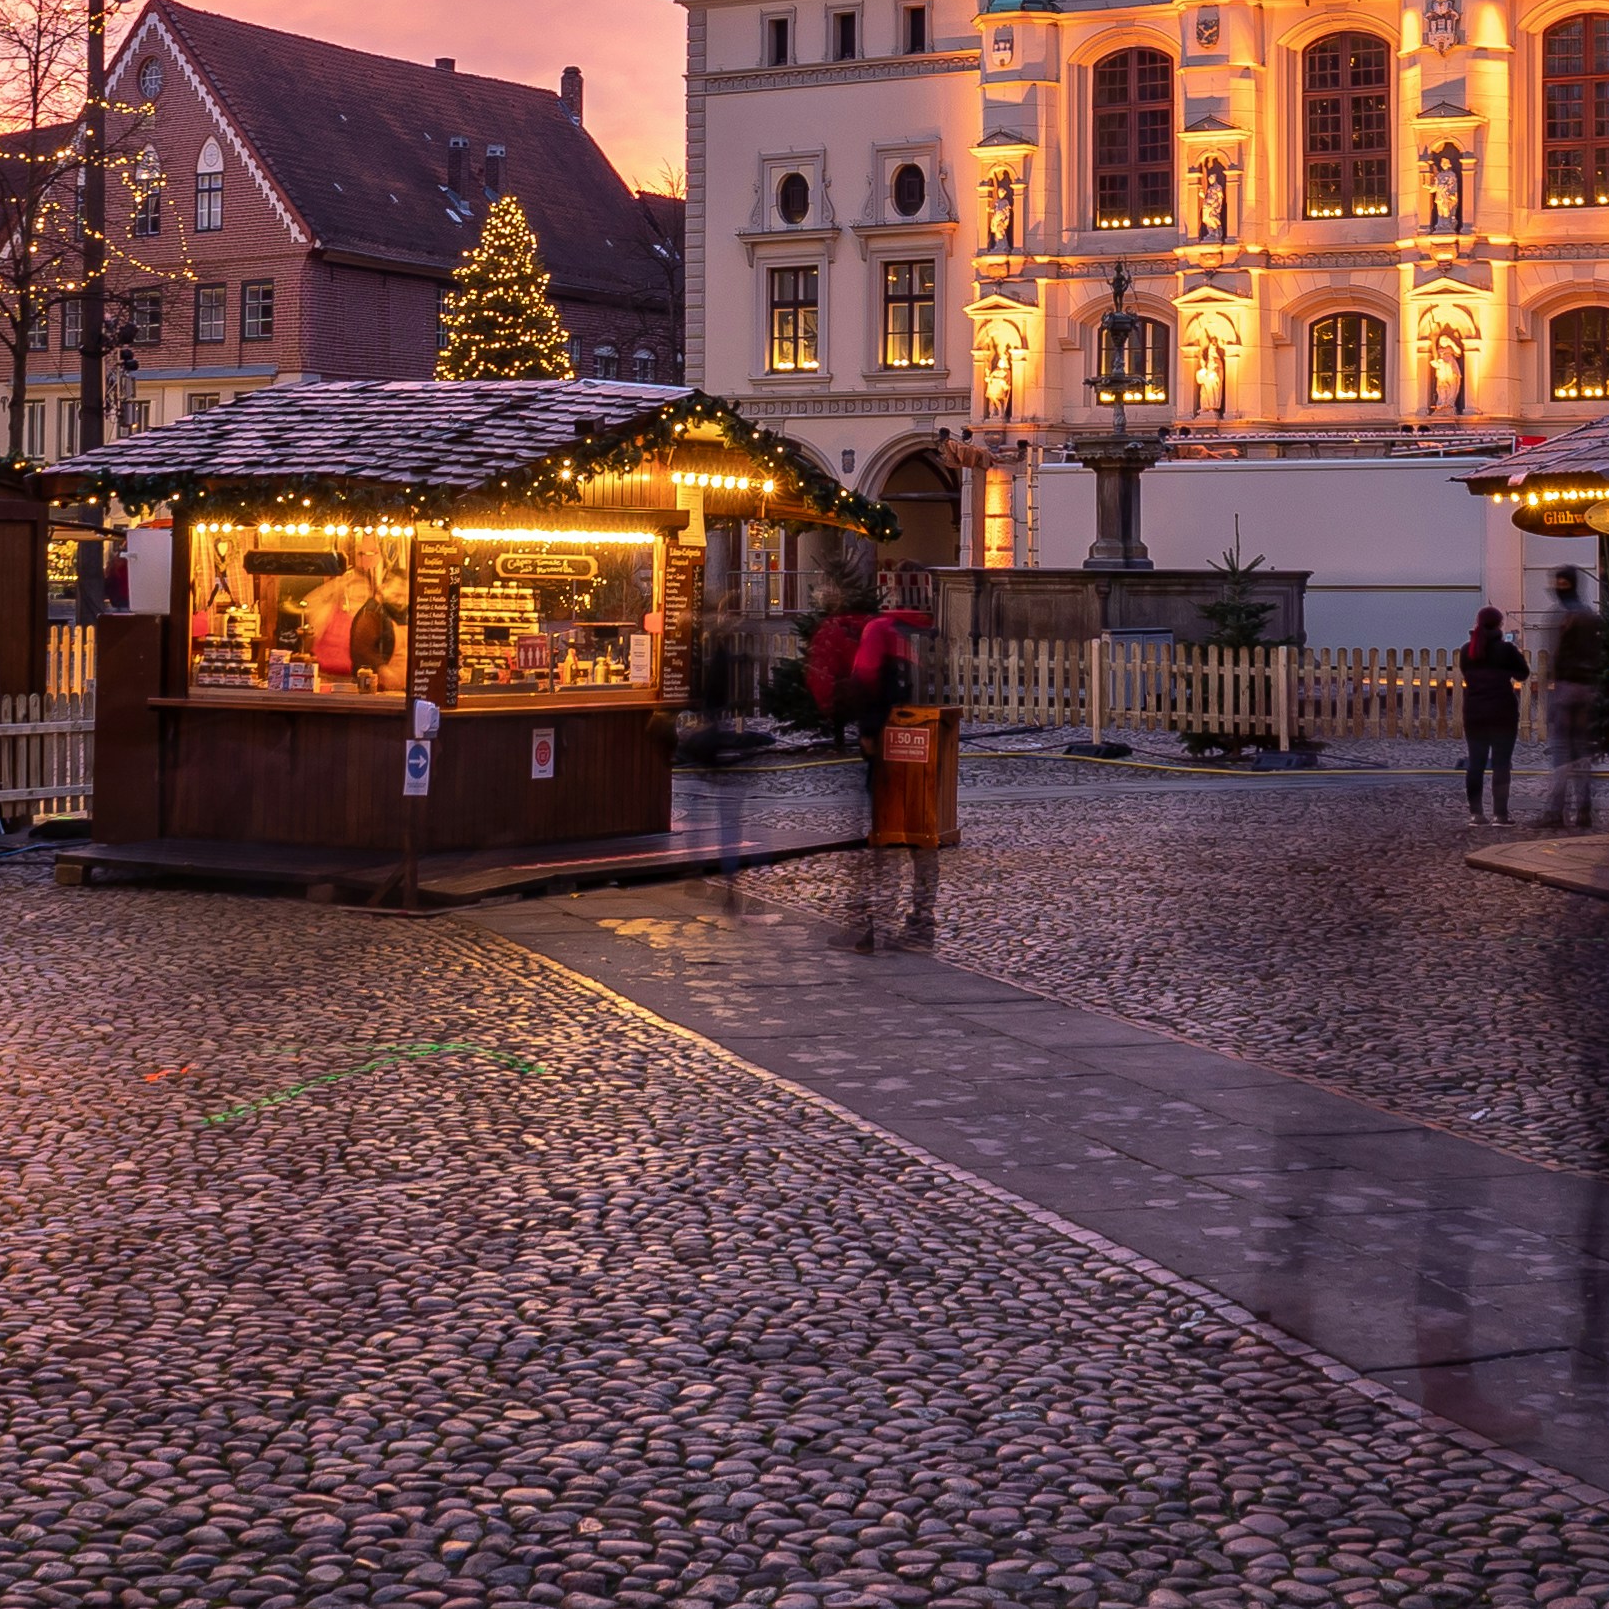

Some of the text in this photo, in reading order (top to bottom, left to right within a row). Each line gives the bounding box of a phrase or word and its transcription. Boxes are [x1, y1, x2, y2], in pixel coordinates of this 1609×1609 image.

[1543, 510, 1586, 524] Glühw
[889, 731, 925, 745] 1.50 m
